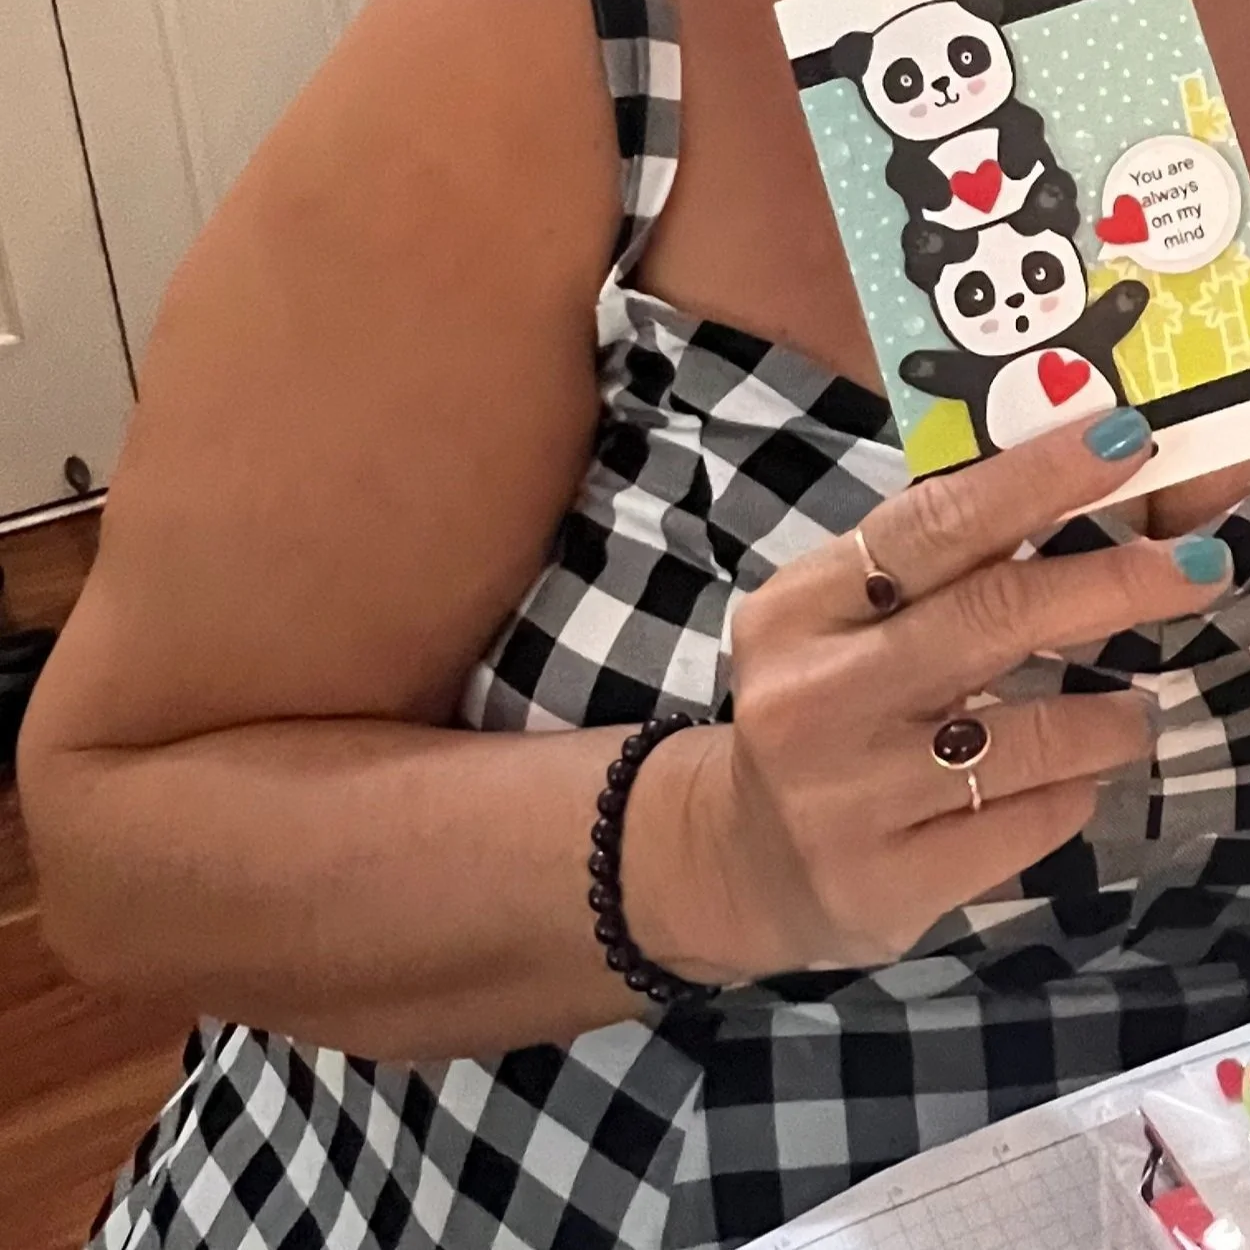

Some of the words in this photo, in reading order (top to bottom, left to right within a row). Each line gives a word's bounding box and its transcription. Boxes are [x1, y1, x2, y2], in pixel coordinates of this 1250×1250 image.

[1128, 168, 1163, 187] You
[1167, 157, 1195, 176] are
[1141, 180, 1199, 209] always
[1151, 211, 1173, 229] on
[1176, 203, 1202, 221] my
[1163, 224, 1205, 250] mind
